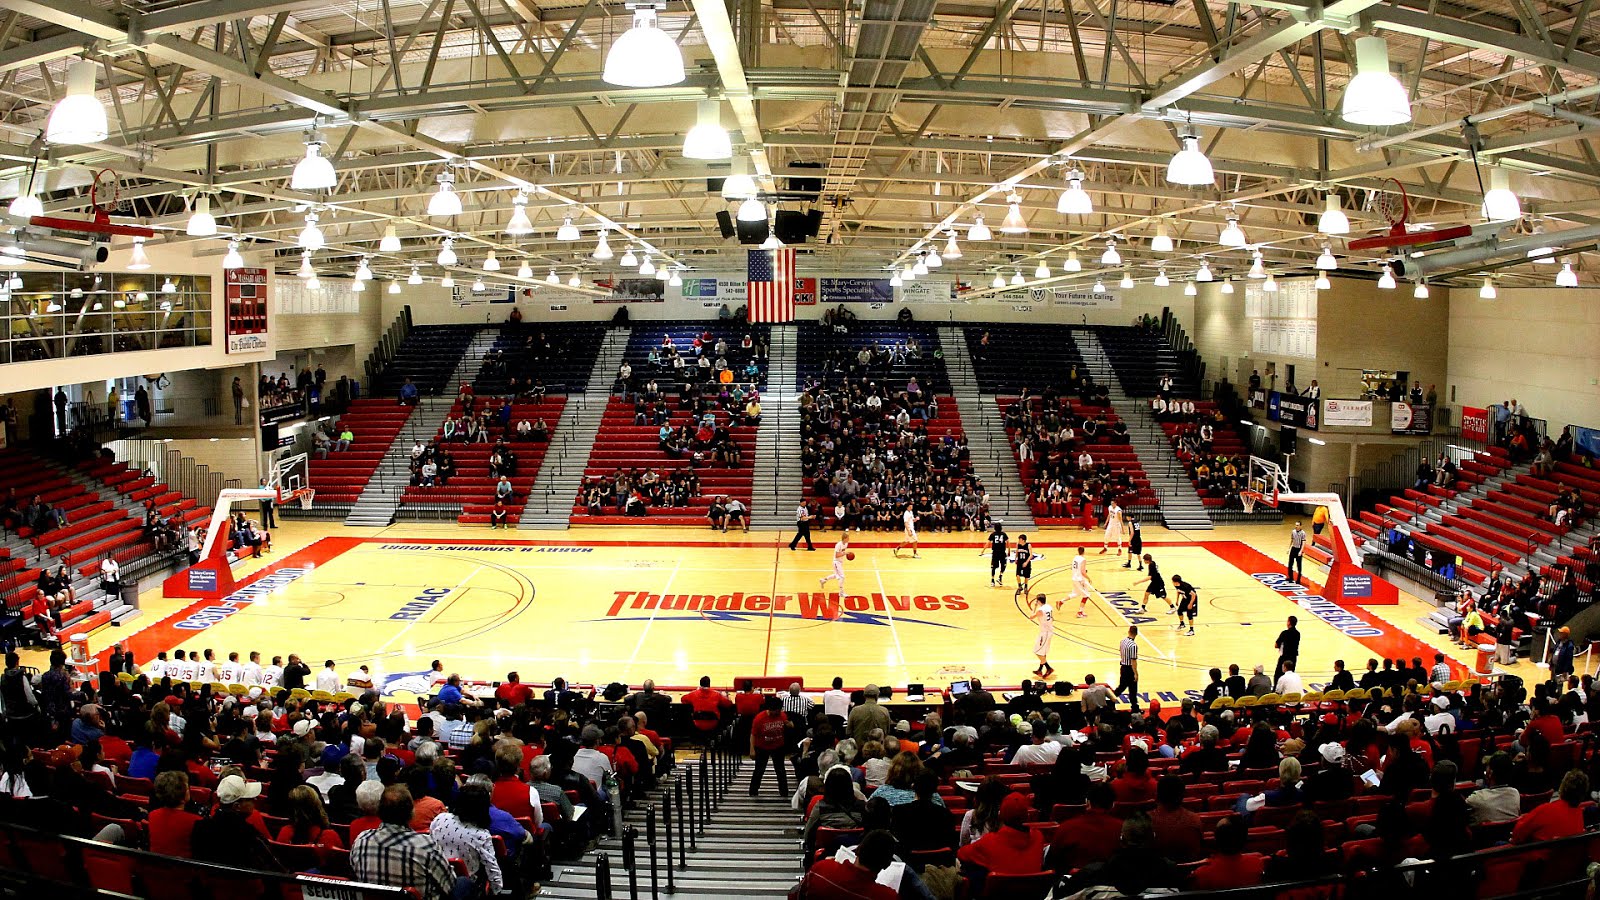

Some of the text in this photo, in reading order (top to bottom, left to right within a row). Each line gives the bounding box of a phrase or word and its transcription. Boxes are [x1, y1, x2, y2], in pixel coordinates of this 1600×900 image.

[830, 279, 874, 288] Mary-Corwin
[821, 286, 875, 294] Sports Specialists
[1094, 293, 1115, 301] Calling.
[994, 535, 1004, 543] 24
[388, 587, 451, 620] RMAC
[605, 591, 970, 620] ThunderWolves
[1100, 592, 1158, 624] NCAA
[167, 667, 178, 677] 20
[262, 674, 272, 685] 12
[1216, 686, 1229, 697] 34
